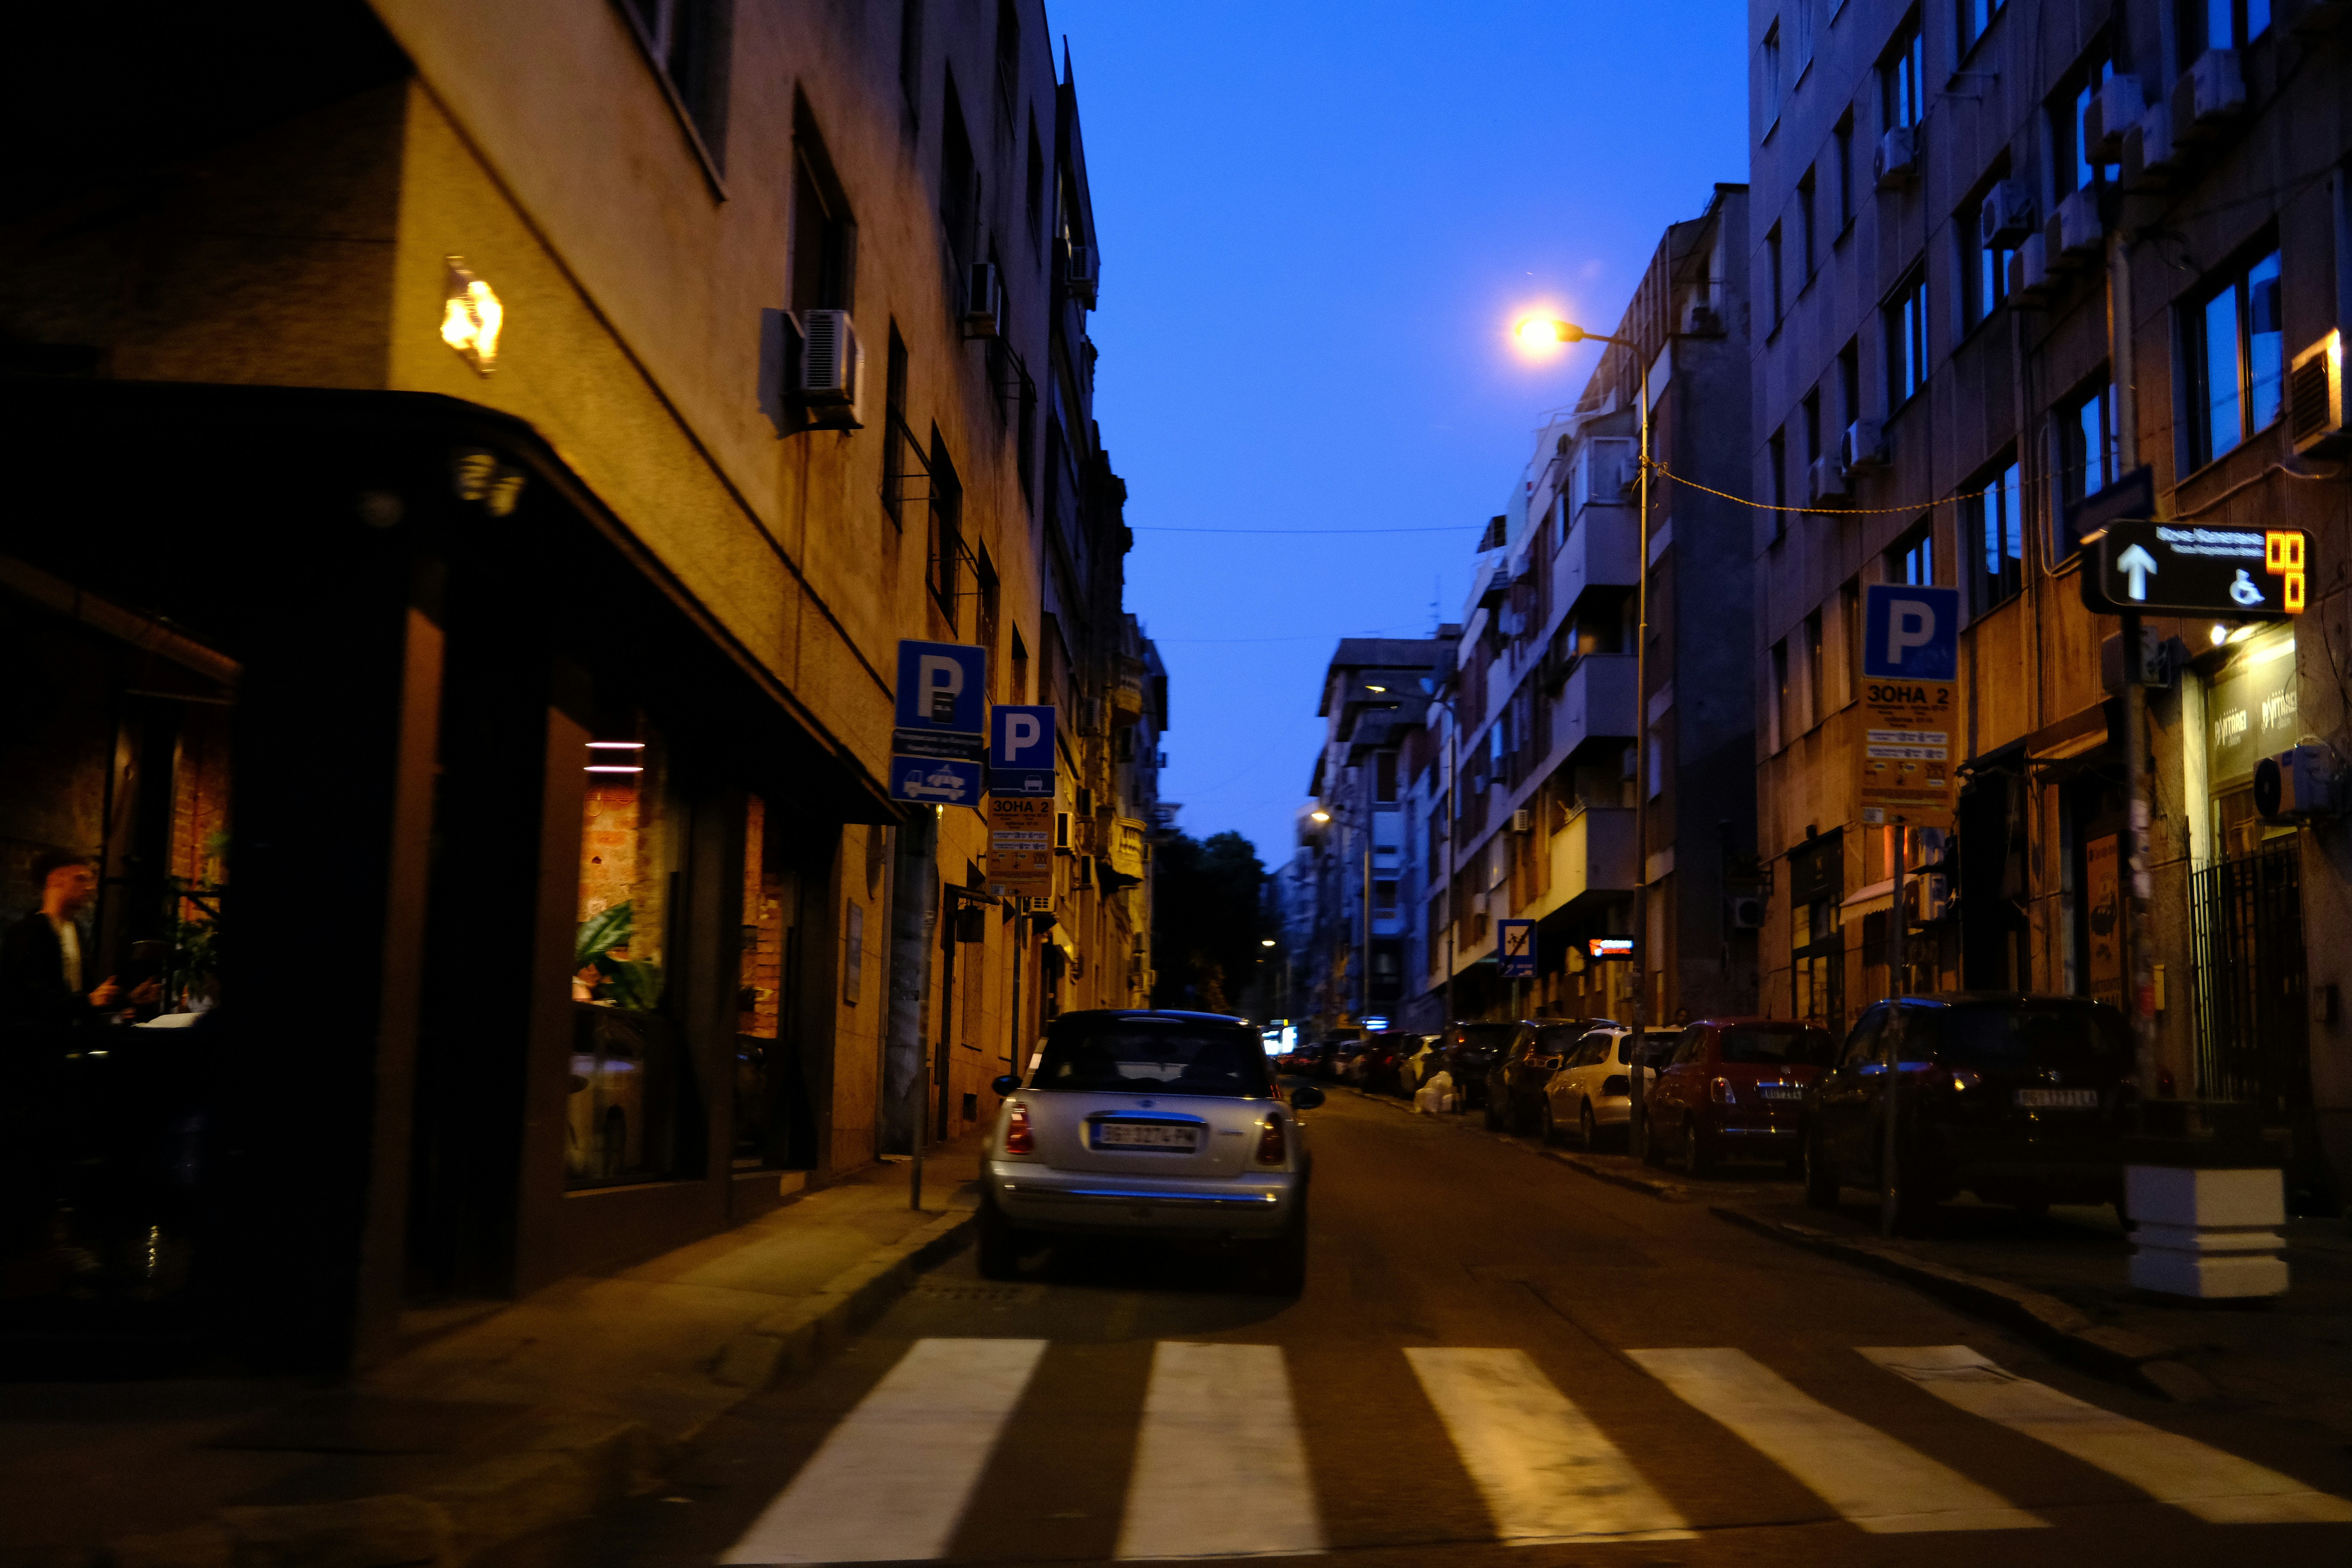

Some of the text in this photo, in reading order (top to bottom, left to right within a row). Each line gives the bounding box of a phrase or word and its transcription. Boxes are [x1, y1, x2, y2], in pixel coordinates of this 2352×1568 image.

[1886, 599, 1936, 664] P
[917, 654, 965, 717] P
[1867, 685, 1949, 704] ЗОНА 2
[1004, 713, 1041, 761] P
[993, 800, 1049, 813] ЗОНА 2
